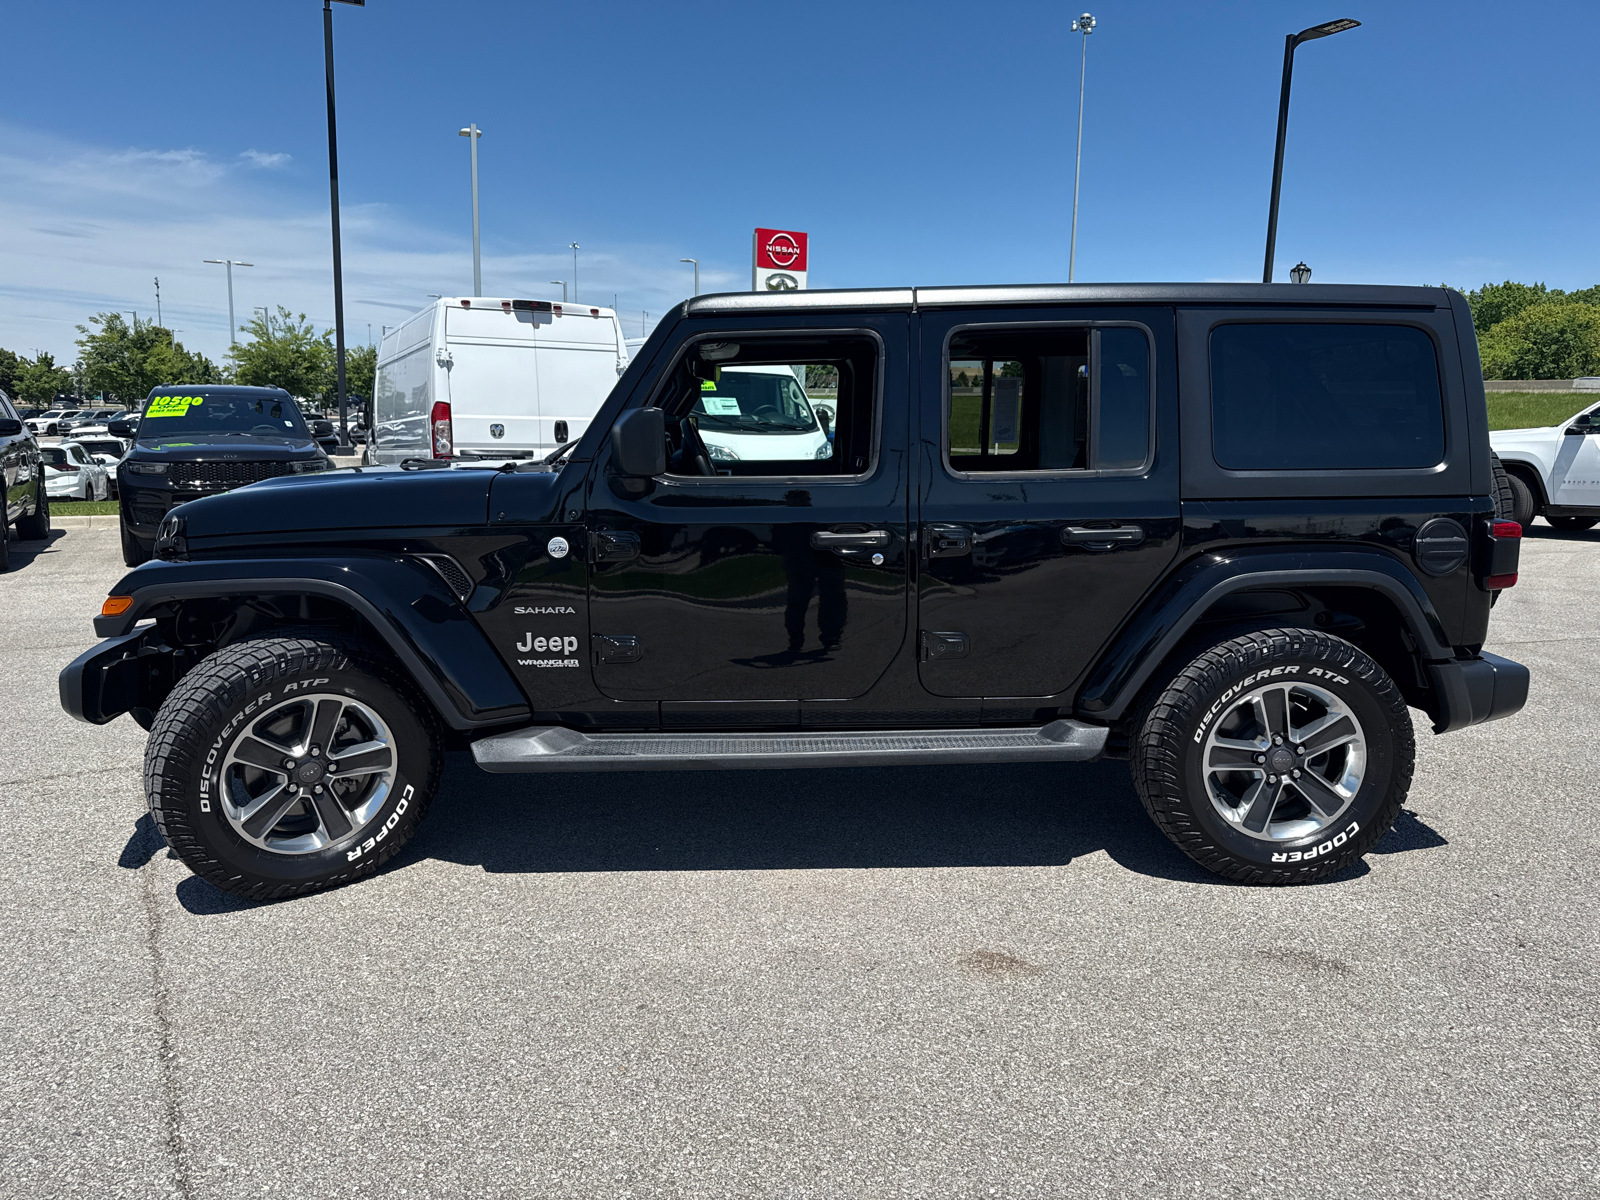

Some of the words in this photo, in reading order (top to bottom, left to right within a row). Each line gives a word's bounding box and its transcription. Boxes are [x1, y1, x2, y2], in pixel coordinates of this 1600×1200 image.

[766, 245, 799, 253] NISSAN
[152, 396, 203, 406] 10500
[514, 606, 575, 614] SAHARA
[516, 632, 578, 655] Jeep
[1194, 665, 1300, 743] DISCOVERER
[1308, 666, 1349, 685] ATP
[200, 692, 272, 813] DISCOVERER
[283, 678, 329, 693] ATP
[346, 784, 415, 862] COOPER
[1271, 821, 1359, 863] COOPER
